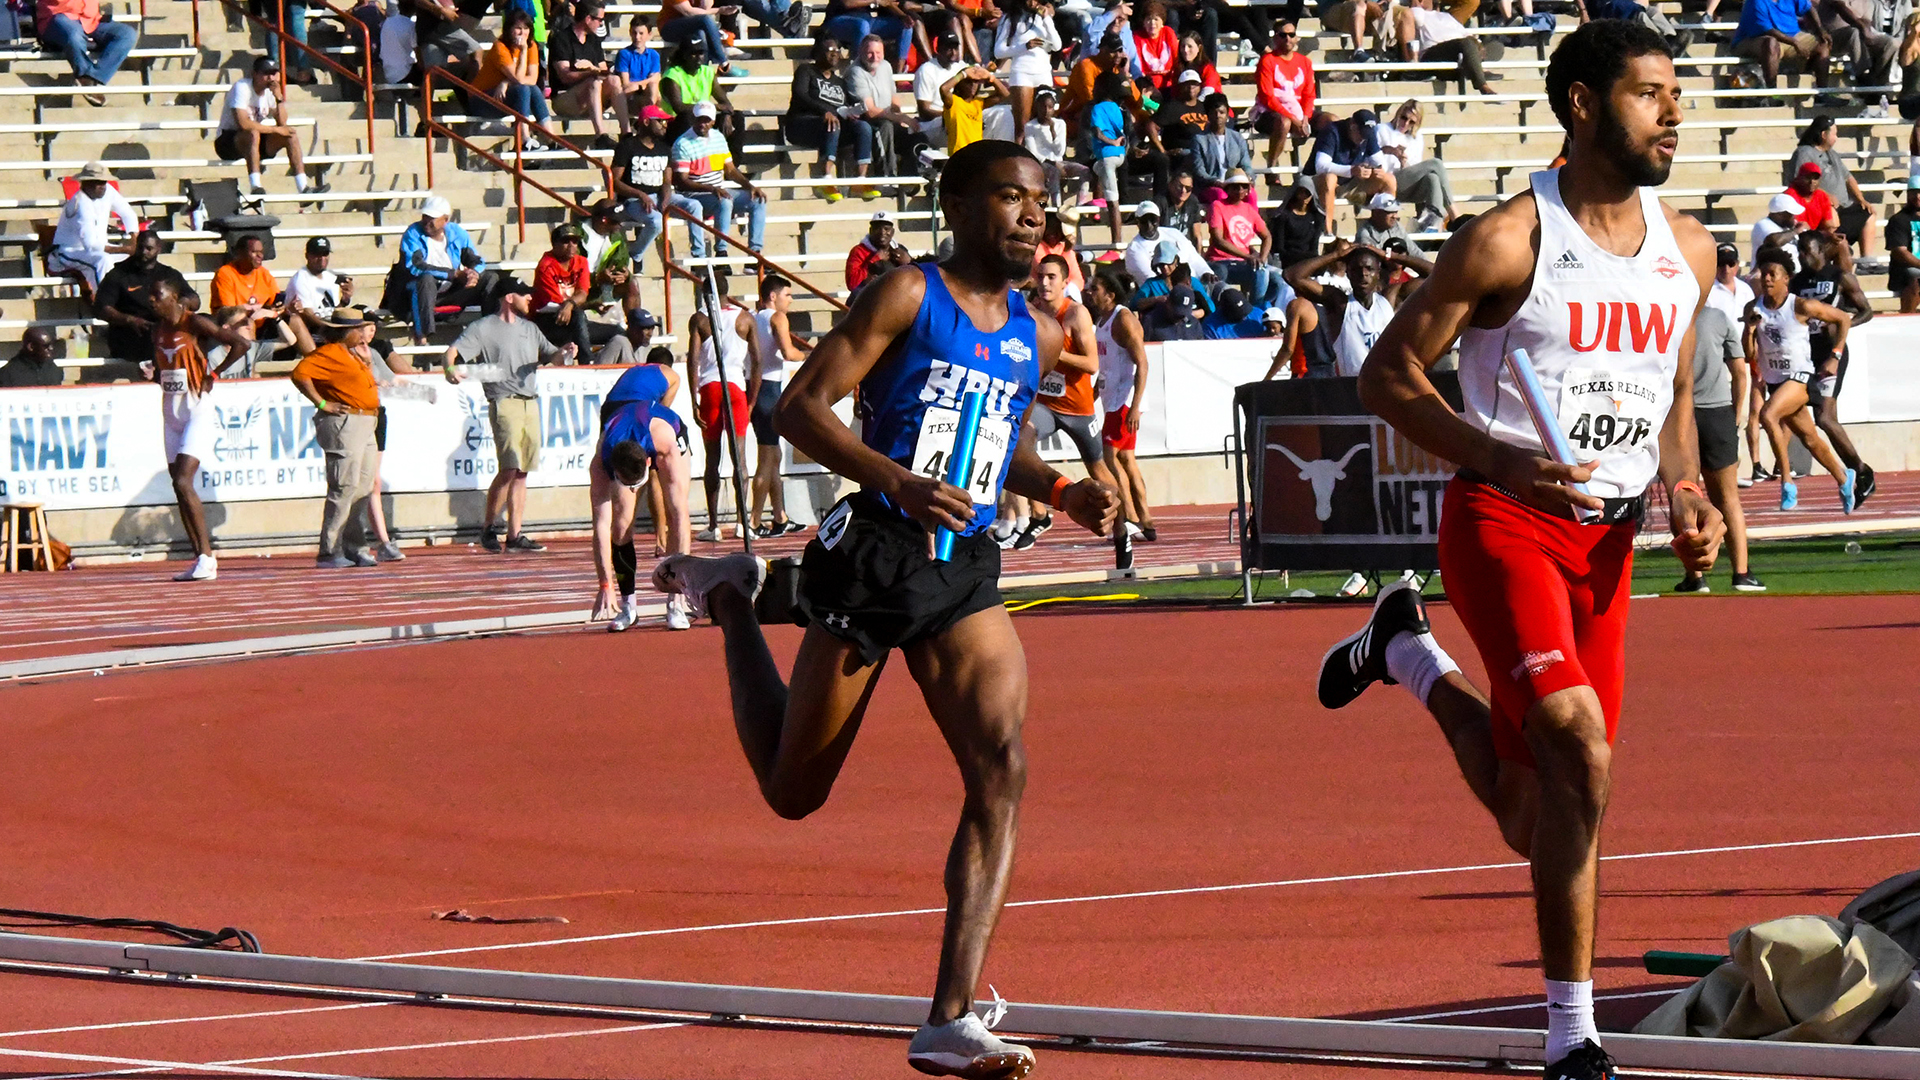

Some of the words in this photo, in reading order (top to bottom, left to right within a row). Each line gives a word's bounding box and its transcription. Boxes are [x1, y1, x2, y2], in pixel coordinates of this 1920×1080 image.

[1553, 261, 1585, 270] adidas
[1818, 282, 1831, 293] 18
[1567, 301, 1678, 354] UIW
[1569, 381, 1614, 396] TEXAS
[1617, 381, 1657, 404] RELAYS
[9, 414, 112, 472] NAVY
[268, 405, 324, 460] NA
[928, 422, 957, 435] TEX
[977, 425, 1005, 450] ELAYS
[201, 469, 266, 488] FORGED
[277, 468, 296, 484] BY
[307, 465, 327, 482] TH
[454, 458, 496, 476] FORG
[558, 454, 585, 470] THE
[18, 480, 37, 495] BY
[48, 477, 79, 494] THE
[88, 475, 122, 492] SEA
